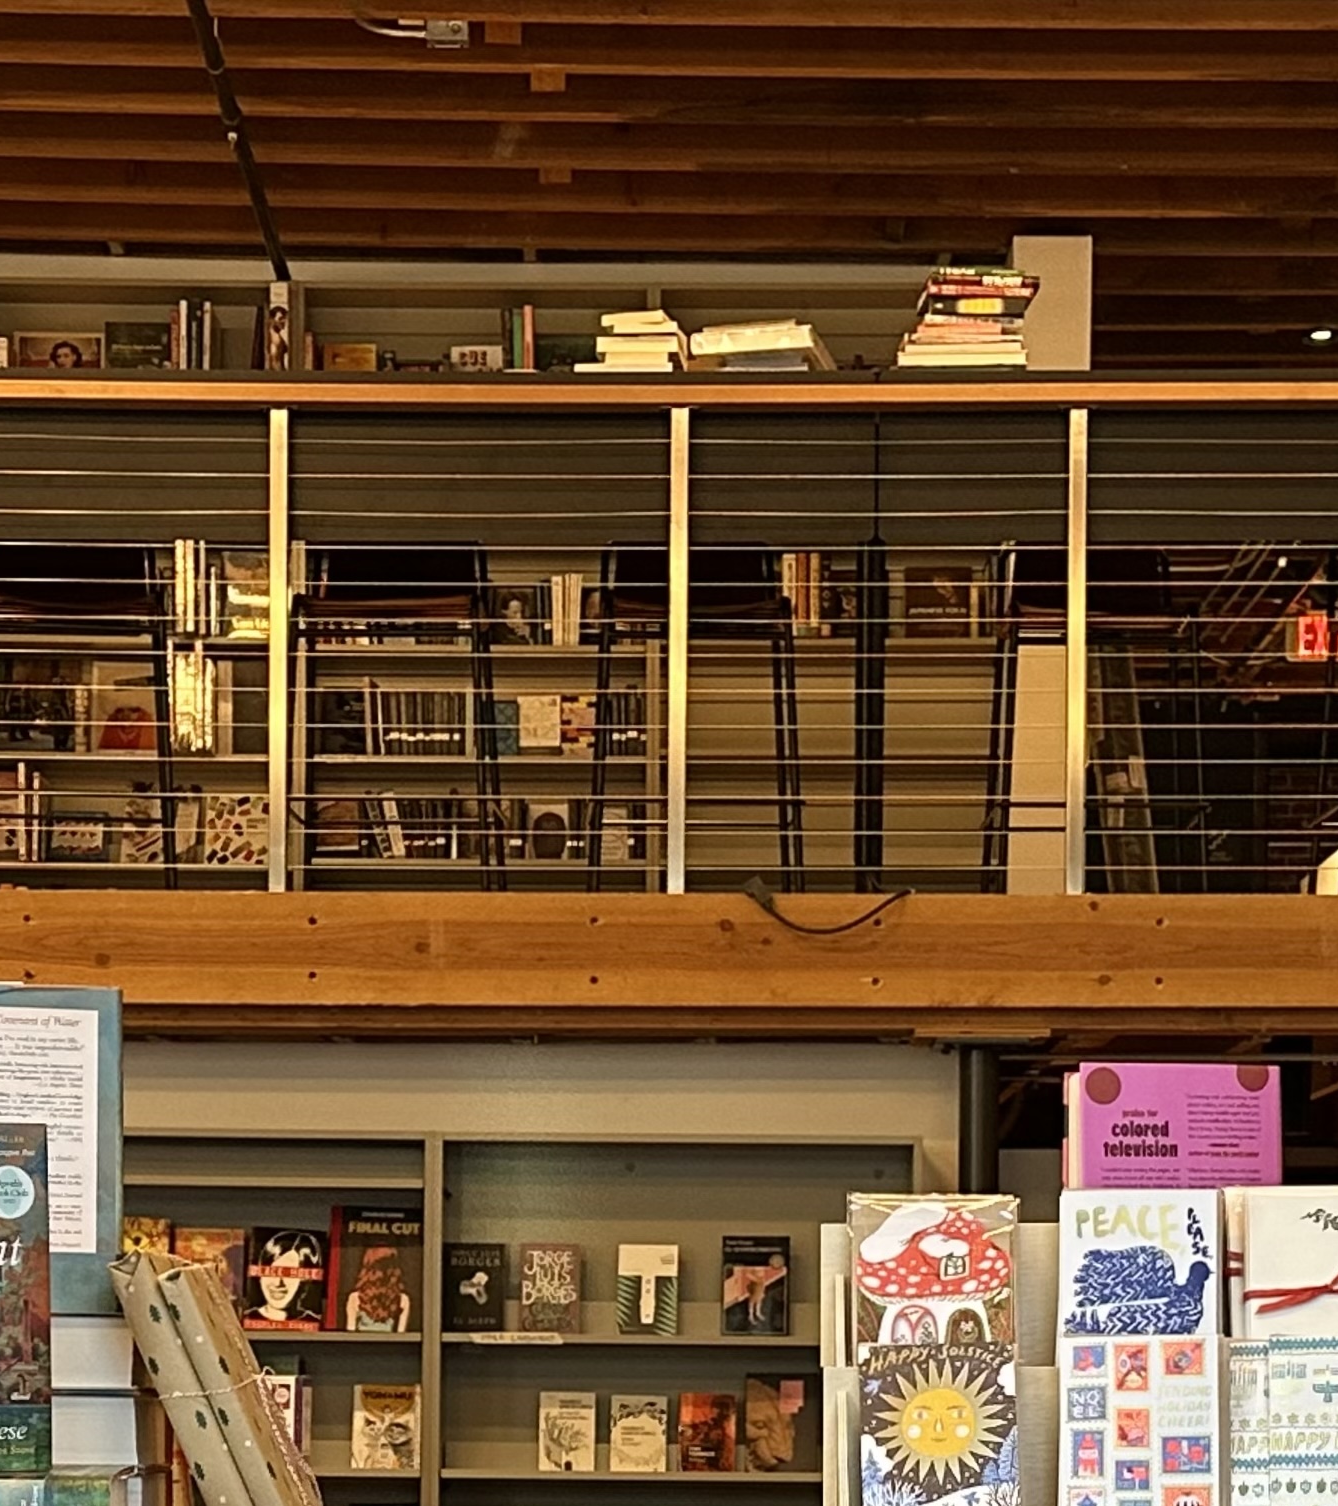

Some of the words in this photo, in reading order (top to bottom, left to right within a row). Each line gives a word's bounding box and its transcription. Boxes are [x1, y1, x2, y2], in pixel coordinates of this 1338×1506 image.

[1112, 1121, 1169, 1137] colored
[1103, 1140, 1178, 1158] television
[348, 1222, 389, 1233] FINAL
[392, 1222, 421, 1234] CUT
[525, 1251, 574, 1274] JORGE
[522, 1279, 577, 1305] BORGES
[869, 1347, 928, 1371] HAPPY
[940, 1342, 1002, 1367] SOLSTICE
